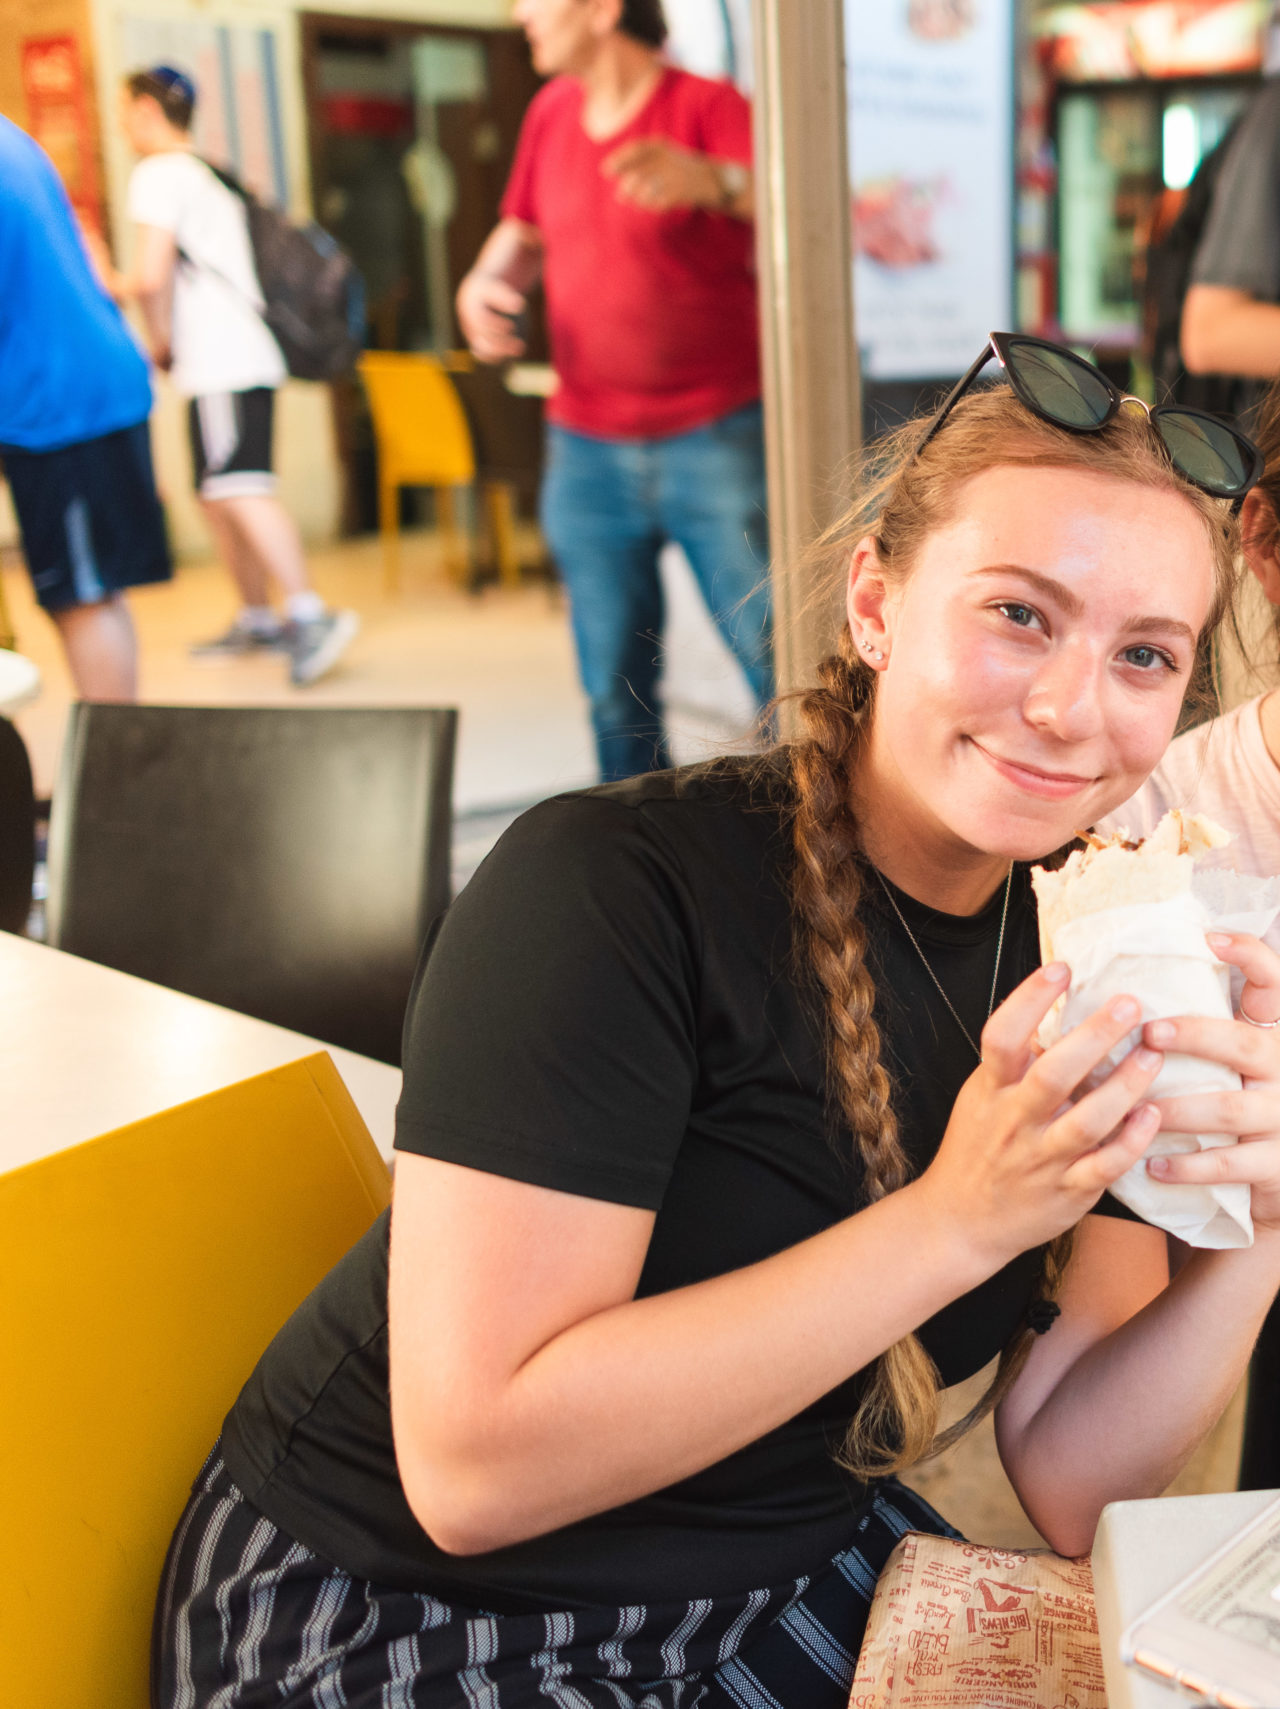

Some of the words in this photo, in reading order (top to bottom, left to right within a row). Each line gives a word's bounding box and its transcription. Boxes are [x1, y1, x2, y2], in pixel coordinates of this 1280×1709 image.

[980, 1616, 1009, 1632] NEWS
[1009, 1613, 1027, 1631] BIG
[906, 1661, 944, 1677] FRESH
[953, 1675, 1037, 1690] BOULANGERIE
[931, 1694, 946, 1703] YOU
[949, 1694, 967, 1703] FONT
[970, 1693, 985, 1702] ANY
[986, 1693, 1004, 1703] WITH
[1005, 1695, 1036, 1709] COMBINE
